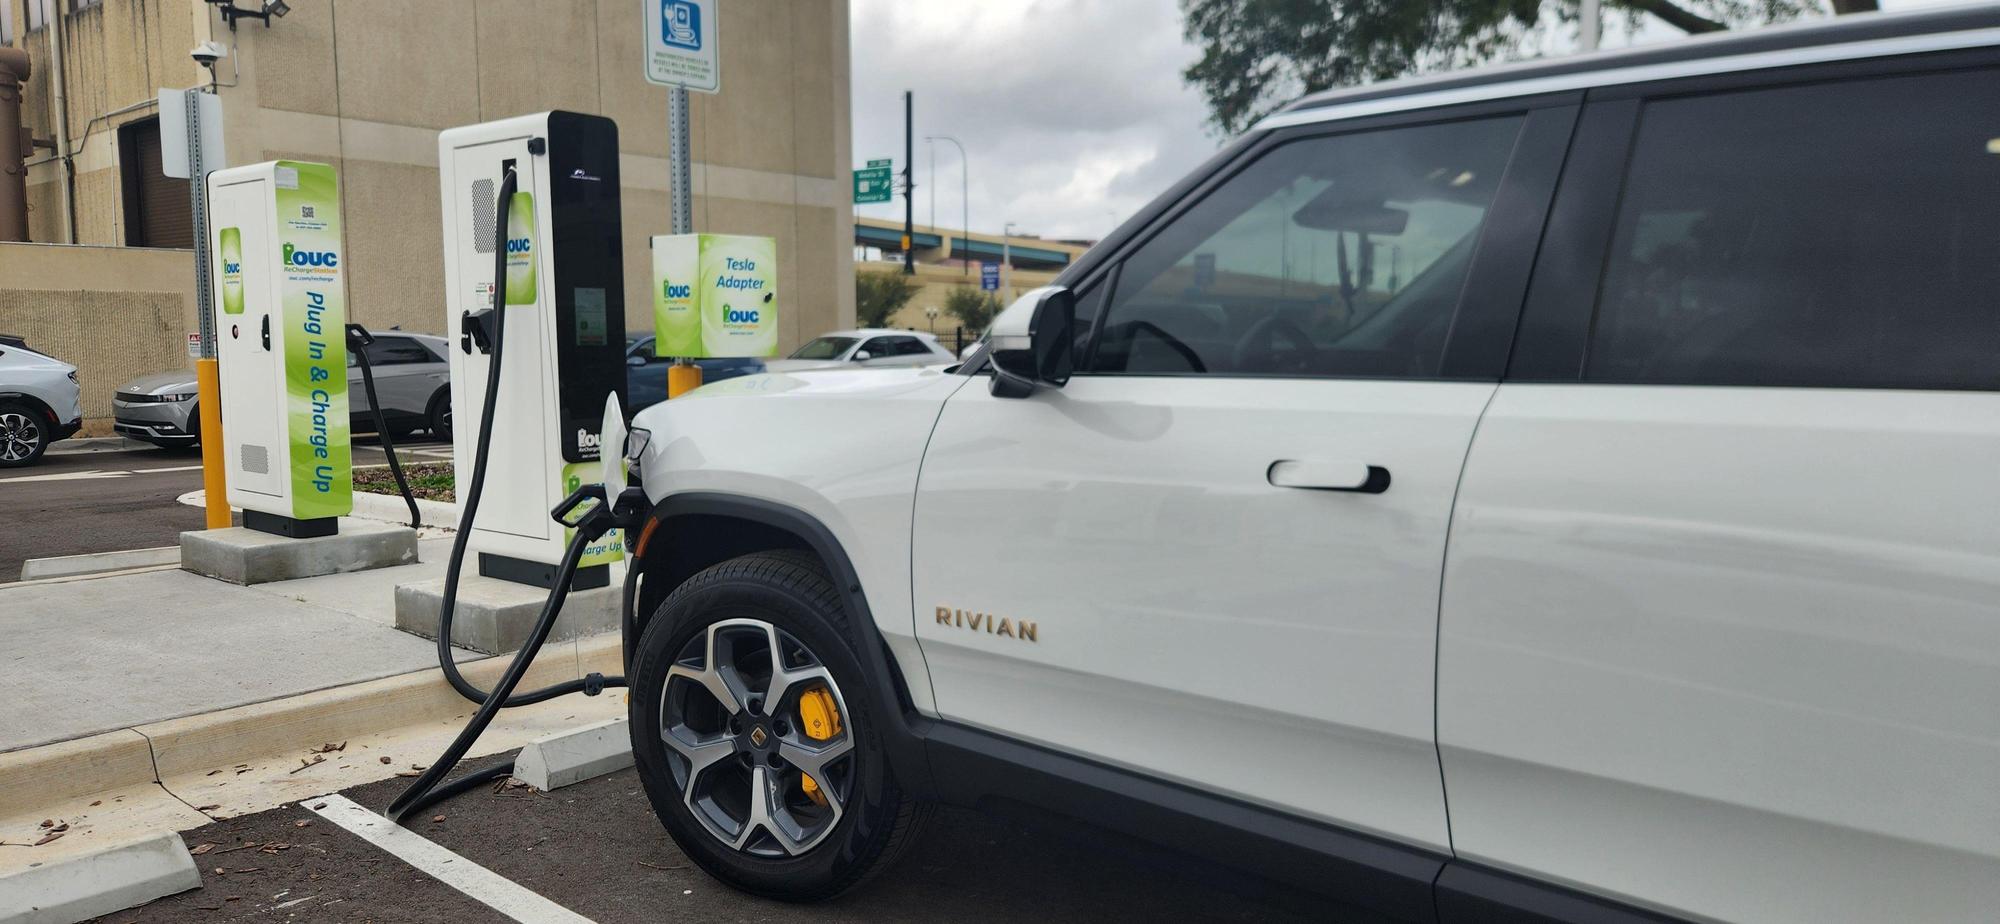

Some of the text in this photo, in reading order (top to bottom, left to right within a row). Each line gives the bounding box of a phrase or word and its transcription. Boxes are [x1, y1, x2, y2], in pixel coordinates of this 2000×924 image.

[726, 257, 755, 271] Tesla
[716, 275, 765, 291] Adapter
[304, 291, 333, 494] Plug In & Charge Up
[609, 542, 623, 552] Up
[935, 605, 1038, 642] RIVIAN
